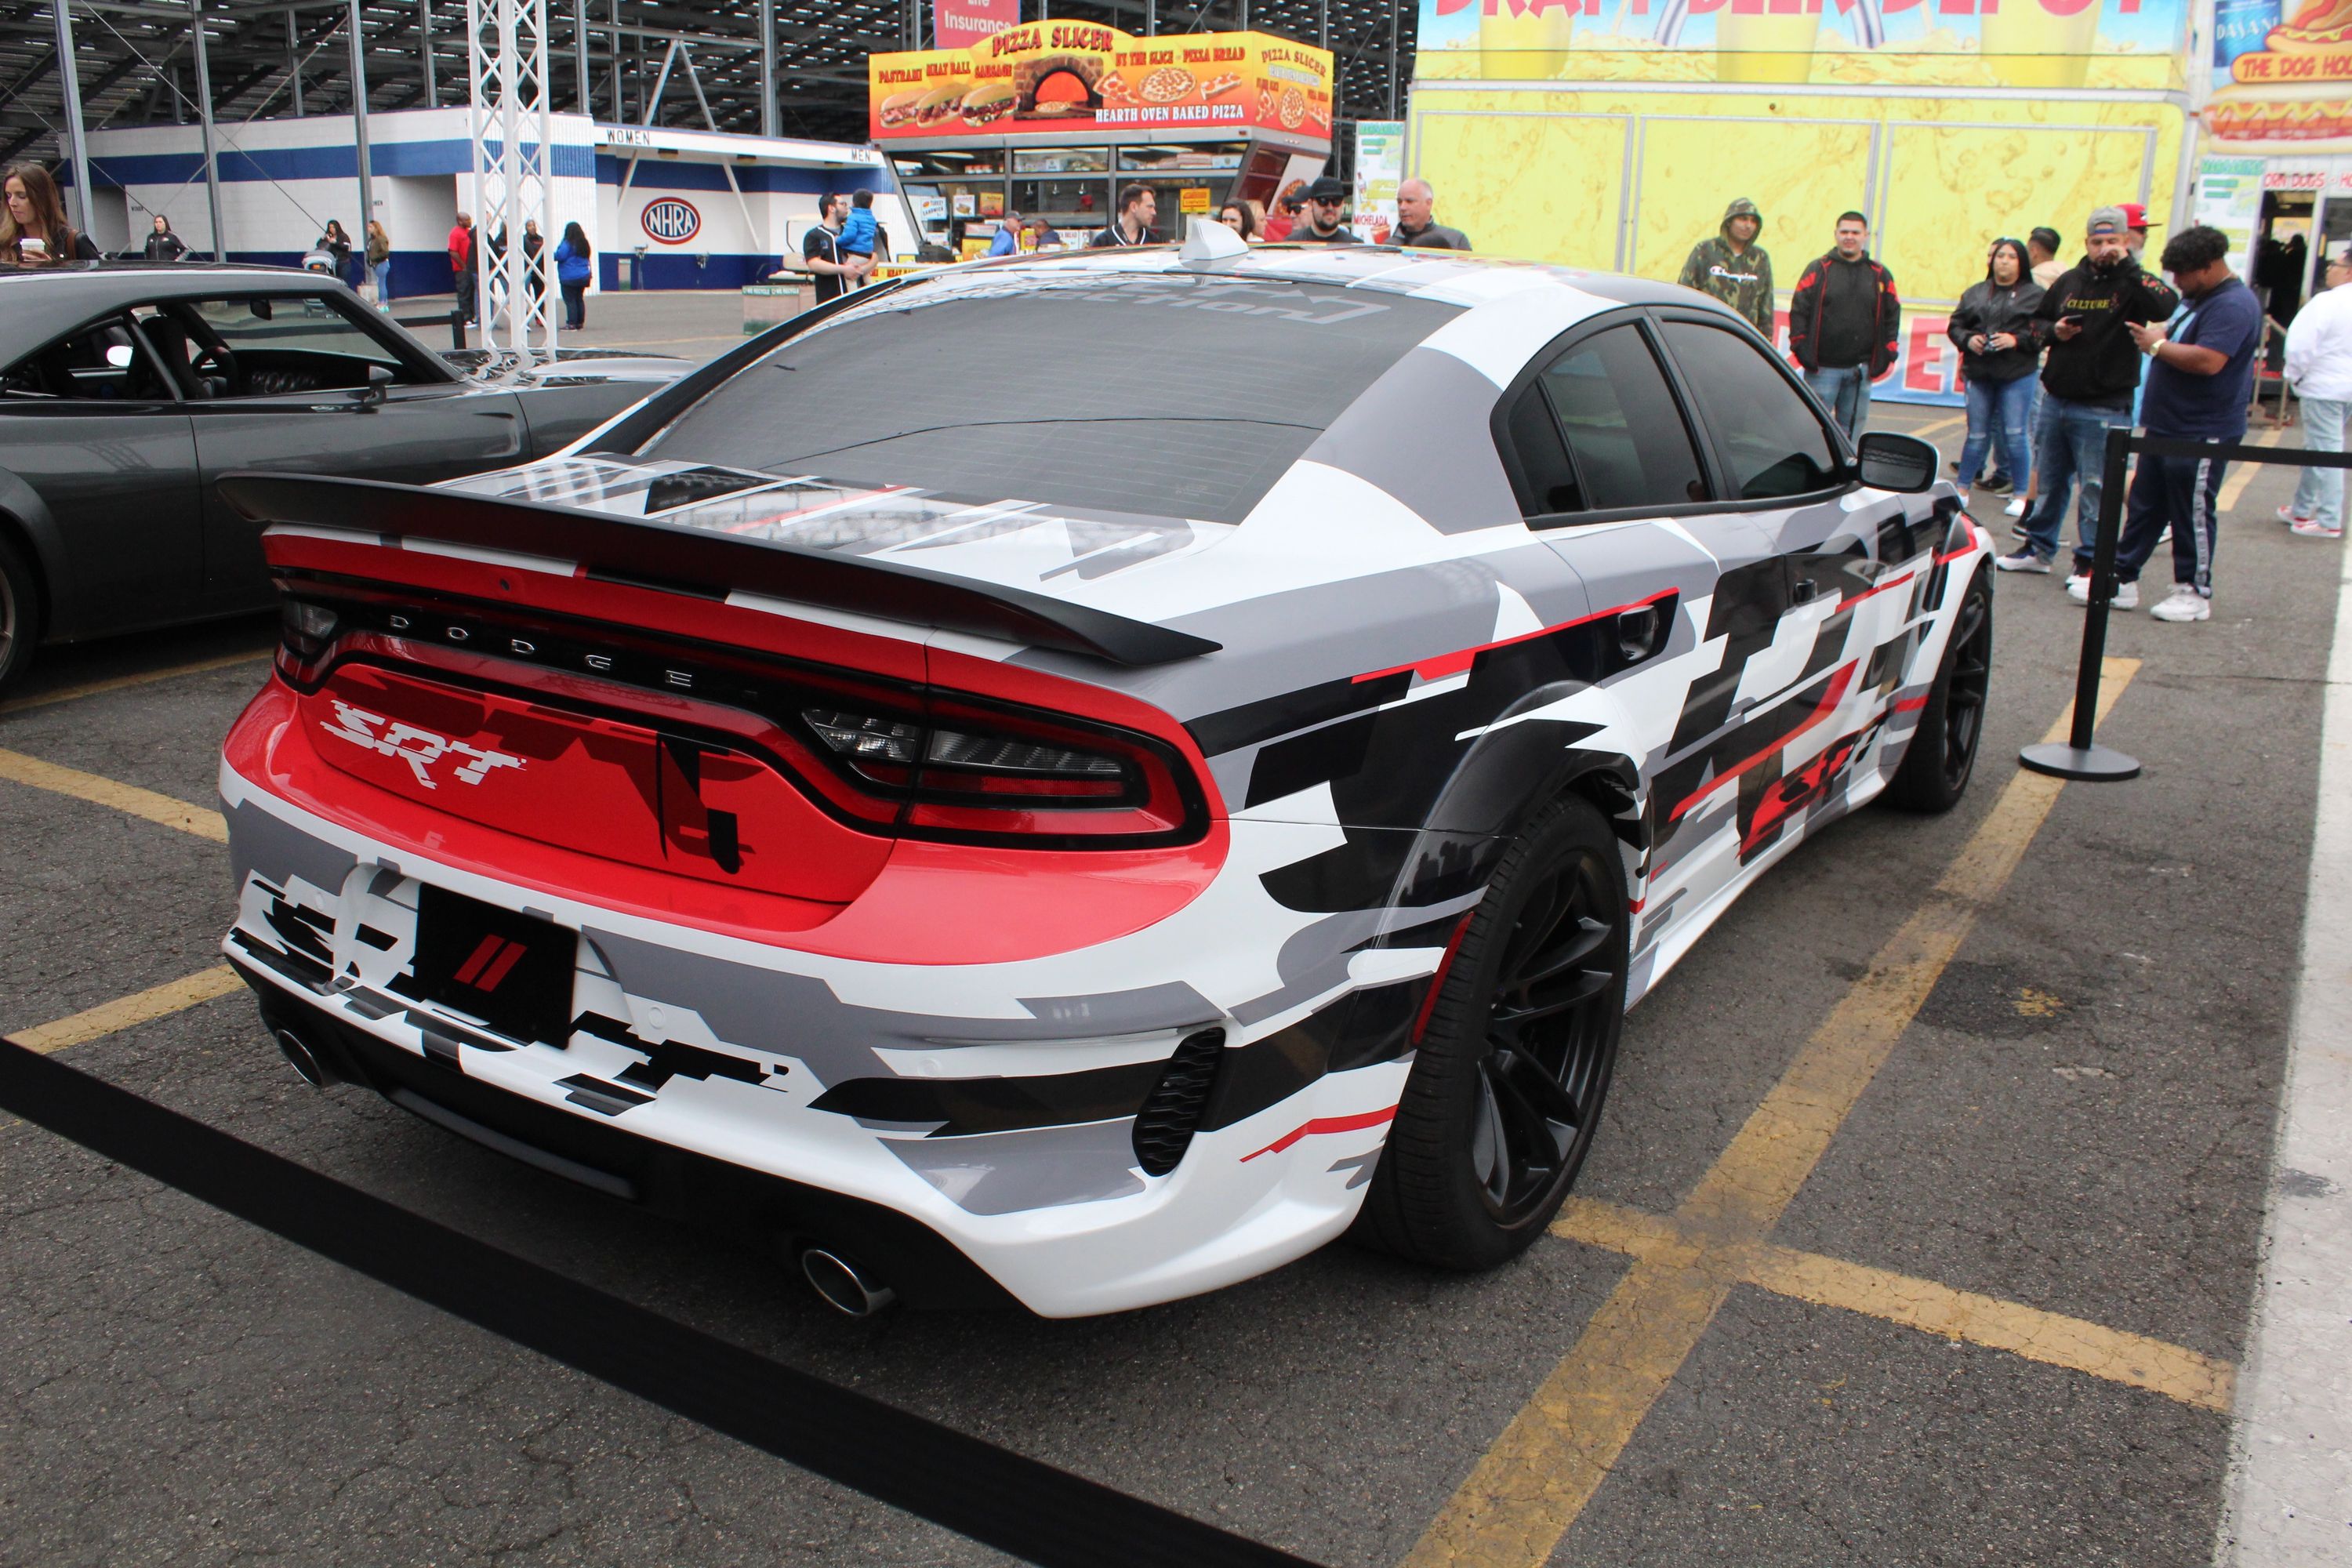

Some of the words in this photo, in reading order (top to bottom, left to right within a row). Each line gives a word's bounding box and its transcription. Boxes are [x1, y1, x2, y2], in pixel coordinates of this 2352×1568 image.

[993, 27, 1042, 56] PIZZA
[1051, 26, 1113, 52] SLICER
[1214, 46, 1245, 62] BREAD
[1261, 49, 1290, 64] PIZZA
[1294, 51, 1327, 78] SLICER
[879, 68, 923, 83] PASTRAMI
[950, 61, 971, 75] BALL
[2243, 58, 2273, 78] THE
[2279, 56, 2316, 76] DOG
[1095, 109, 1138, 123] HEARTH
[1142, 107, 1169, 122] OVEN
[1173, 106, 1209, 120] BAKED
[1212, 104, 1244, 119] PIZZA
[607, 129, 651, 146] WOMEN
[851, 149, 871, 162] MEN
[648, 204, 695, 237] NHRA
[2067, 299, 2111, 310] CULTURE
[390, 614, 693, 688] DODGE
[319, 699, 528, 791] SRT
